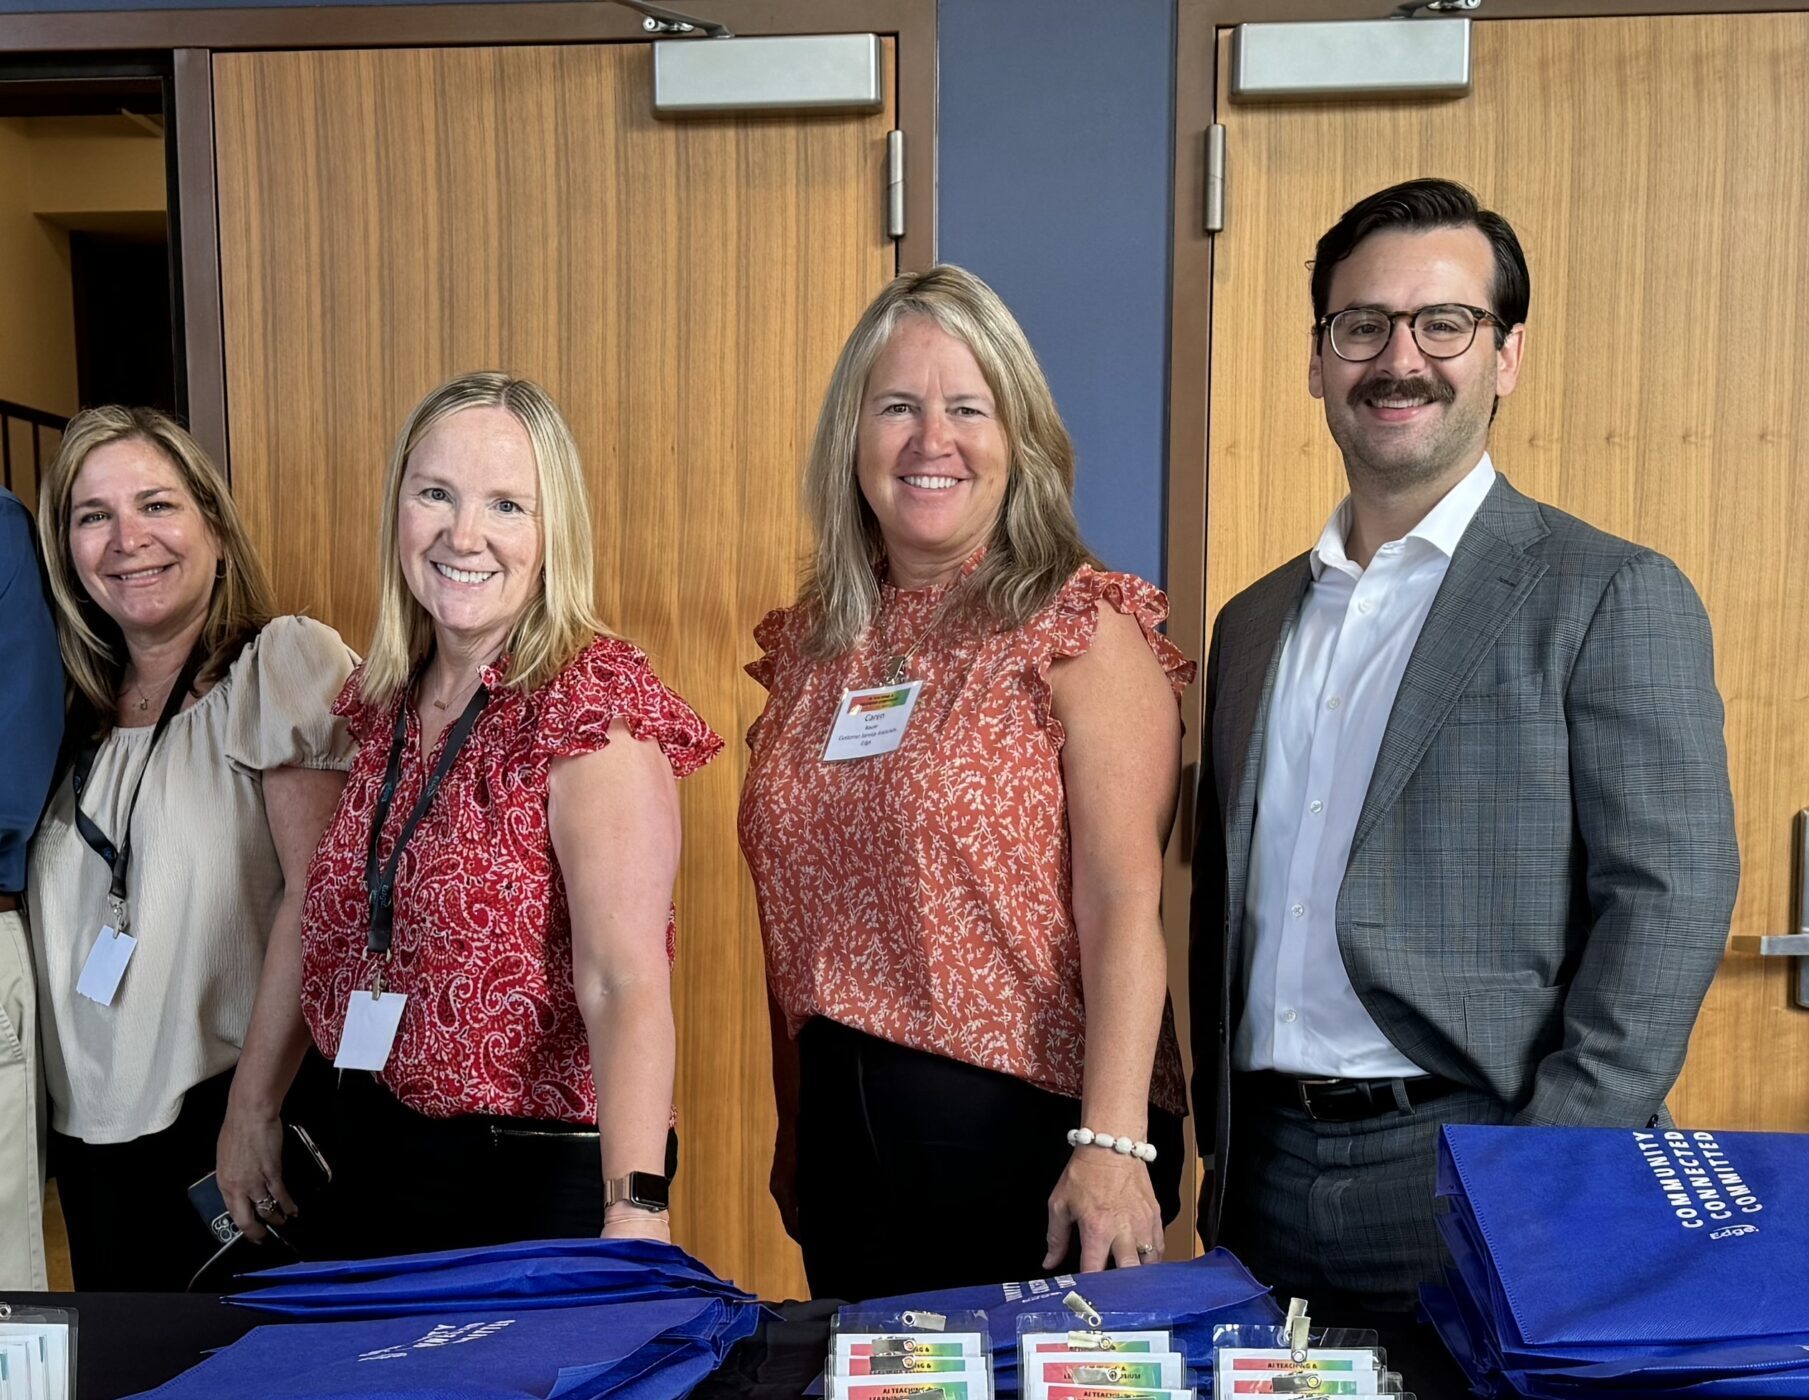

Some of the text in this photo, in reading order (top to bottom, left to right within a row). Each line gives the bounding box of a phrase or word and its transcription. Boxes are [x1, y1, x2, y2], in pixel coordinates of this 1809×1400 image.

[1633, 1131, 1704, 1229] COMMUNITY
[1664, 1131, 1732, 1220] CONNECTED
[1693, 1131, 1763, 1214] COMMITTED
